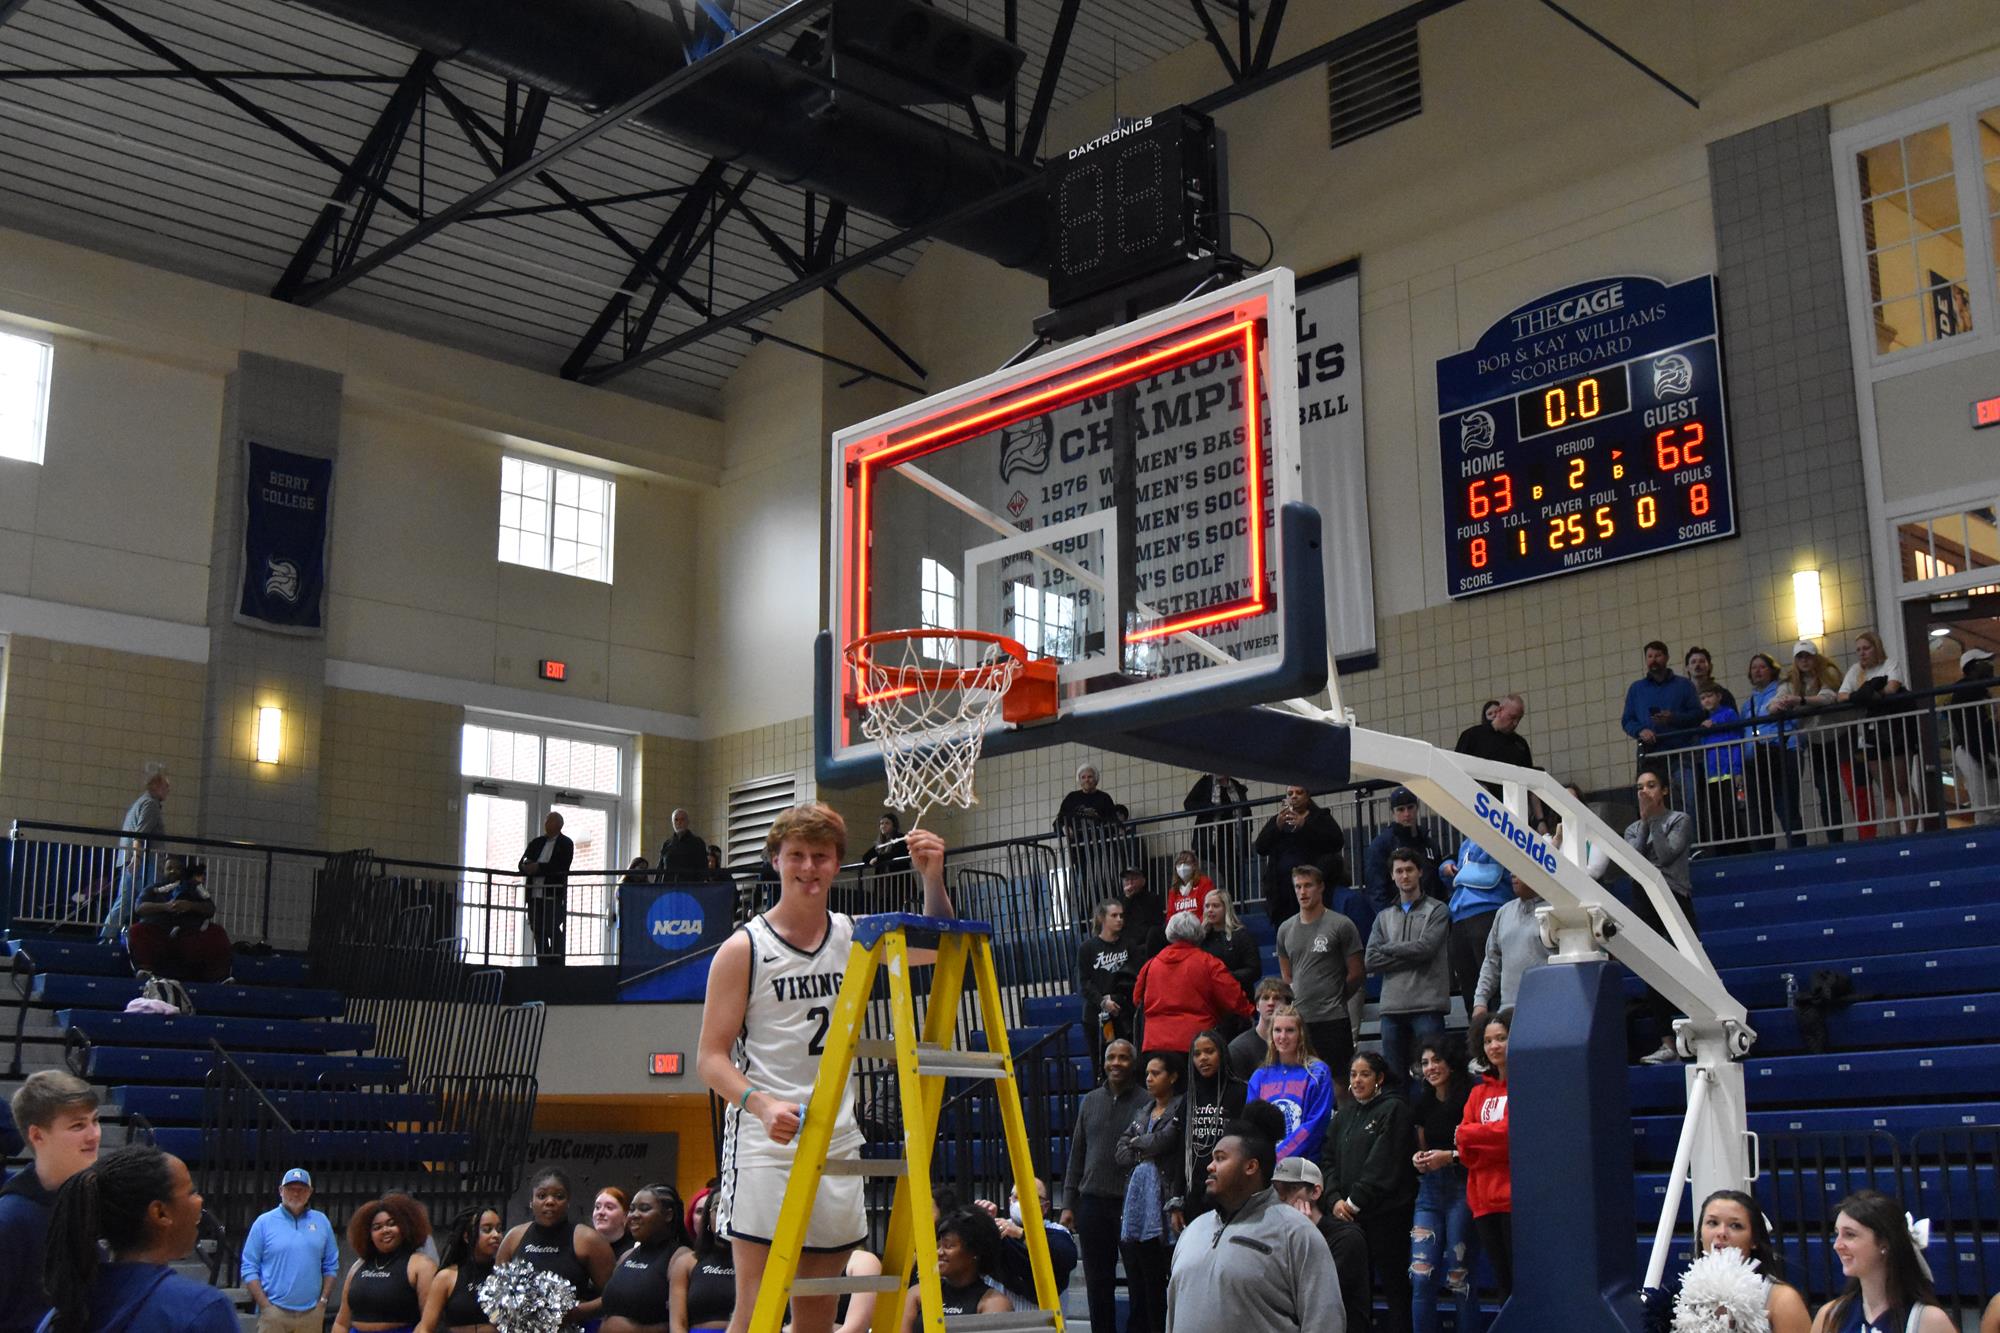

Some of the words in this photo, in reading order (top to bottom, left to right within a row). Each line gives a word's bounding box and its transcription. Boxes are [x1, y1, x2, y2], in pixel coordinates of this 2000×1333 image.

[1069, 116, 1153, 160] DAKTRONICS
[1477, 350, 1511, 375] BOB
[1515, 346, 1528, 362] &
[1533, 334, 1567, 358] KAY
[1576, 304, 1667, 344] WILLIAMS
[1511, 336, 1632, 384] SCOREBOARD
[1060, 343, 1345, 463] CHMPINS
[1644, 397, 1699, 429] GUEST
[1556, 436, 1595, 458] PERIOD
[1656, 423, 1704, 471] 62
[1041, 474, 1088, 504] 1976
[1100, 441, 1197, 486] WMEN'S
[1461, 451, 1505, 478] HOME
[1569, 458, 1585, 490] 2
[1674, 465, 1712, 486] FOULS
[269, 471, 310, 491] BERRY
[262, 487, 316, 510] COLLEGE
[1469, 474, 1512, 519] 63
[1541, 498, 1583, 519] PLAYER
[1589, 489, 1618, 506] FOUL
[1690, 483, 1709, 516] 8
[1042, 503, 1088, 527] 1987
[1637, 496, 1656, 528] 0
[1457, 521, 1490, 540] FOULS
[1519, 529, 1526, 555] 1
[1549, 514, 1585, 550] 25
[1596, 507, 1614, 539] 5
[1678, 520, 1717, 540] SCORE
[1470, 537, 1487, 568] 8
[1563, 547, 1603, 567] MATCH
[1172, 553, 1225, 584] GOLF
[1460, 572, 1493, 591] SCORE
[547, 662, 565, 679] EXIT
[1474, 792, 1557, 874] Schelde
[652, 919, 703, 936] NCAA
[772, 972, 844, 1002] VIKING
[655, 1054, 679, 1073] EXIT
[528, 1138, 649, 1166] yVBCamps.com
[702, 1264, 735, 1276] Vikette
